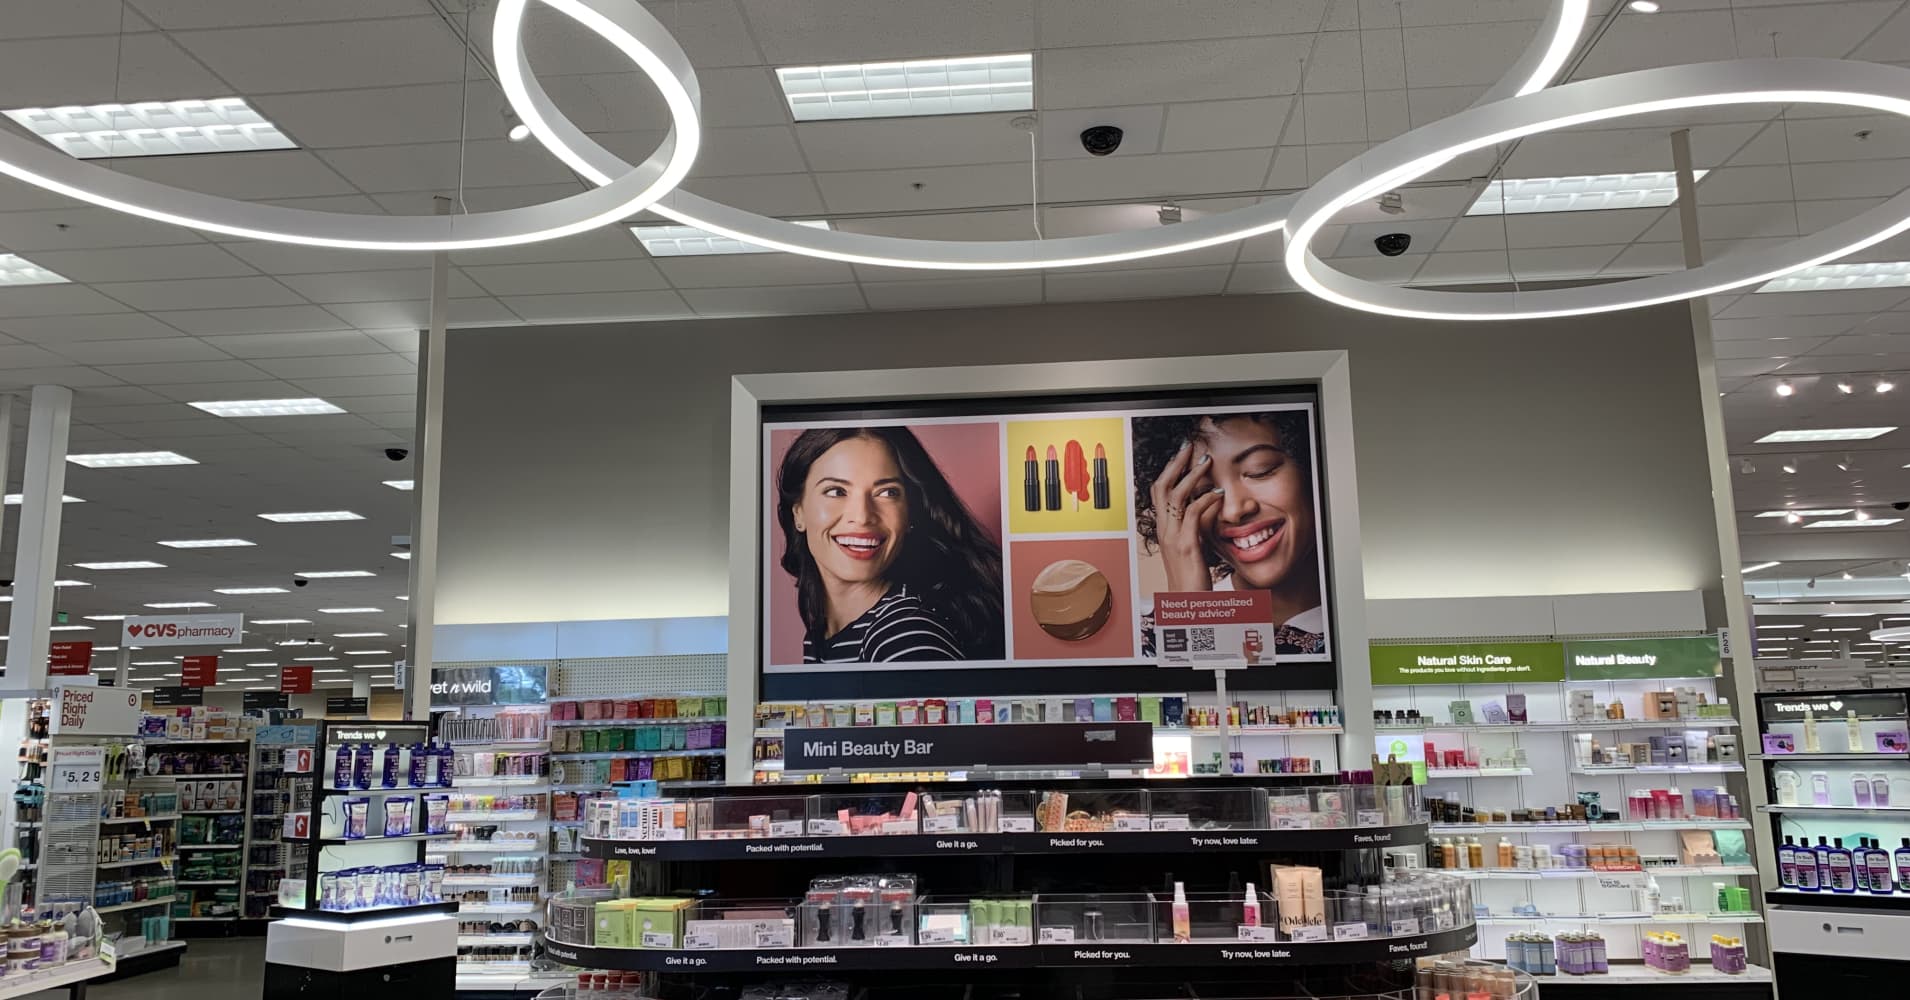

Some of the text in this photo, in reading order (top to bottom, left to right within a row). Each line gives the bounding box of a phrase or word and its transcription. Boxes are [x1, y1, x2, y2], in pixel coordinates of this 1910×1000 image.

[1161, 598, 1253, 609] Need personalized
[1162, 609, 1236, 619] beauty advice?
[143, 623, 235, 639] CVS pharmacy
[1722, 632, 1730, 654] F26
[1417, 654, 1511, 666] Natural Skin Care
[1575, 654, 1656, 666] Natural Beauty
[430, 681, 448, 694] et
[461, 679, 492, 693] wild
[63, 689, 93, 703] Priced
[62, 703, 87, 717] Right
[1774, 702, 1829, 712] Trends we
[61, 715, 85, 729] Daily
[337, 731, 376, 740] Trends we
[803, 740, 933, 759] Mini Beauty Bar
[1076, 838, 1086, 846] for
[1087, 840, 1104, 848] you.
[1191, 838, 1203, 846] Try
[1222, 837, 1239, 845] love
[1239, 836, 1259, 845] later.
[1354, 834, 1374, 843] Faves,
[745, 843, 825, 853] Packed with potential.
[936, 840, 953, 848] Give
[954, 840, 959, 848] it
[966, 842, 978, 850] go.
[1388, 941, 1428, 953] Faves, found!
[756, 955, 838, 965] Packed with potential.
[954, 953, 972, 962] Give
[972, 953, 978, 961] it
[985, 954, 998, 963] go.
[1074, 950, 1131, 960] Picked for you.
[1221, 950, 1291, 960] Try now, love later.
[665, 957, 682, 965] Give
[683, 956, 688, 965] it
[695, 958, 707, 967] go.
